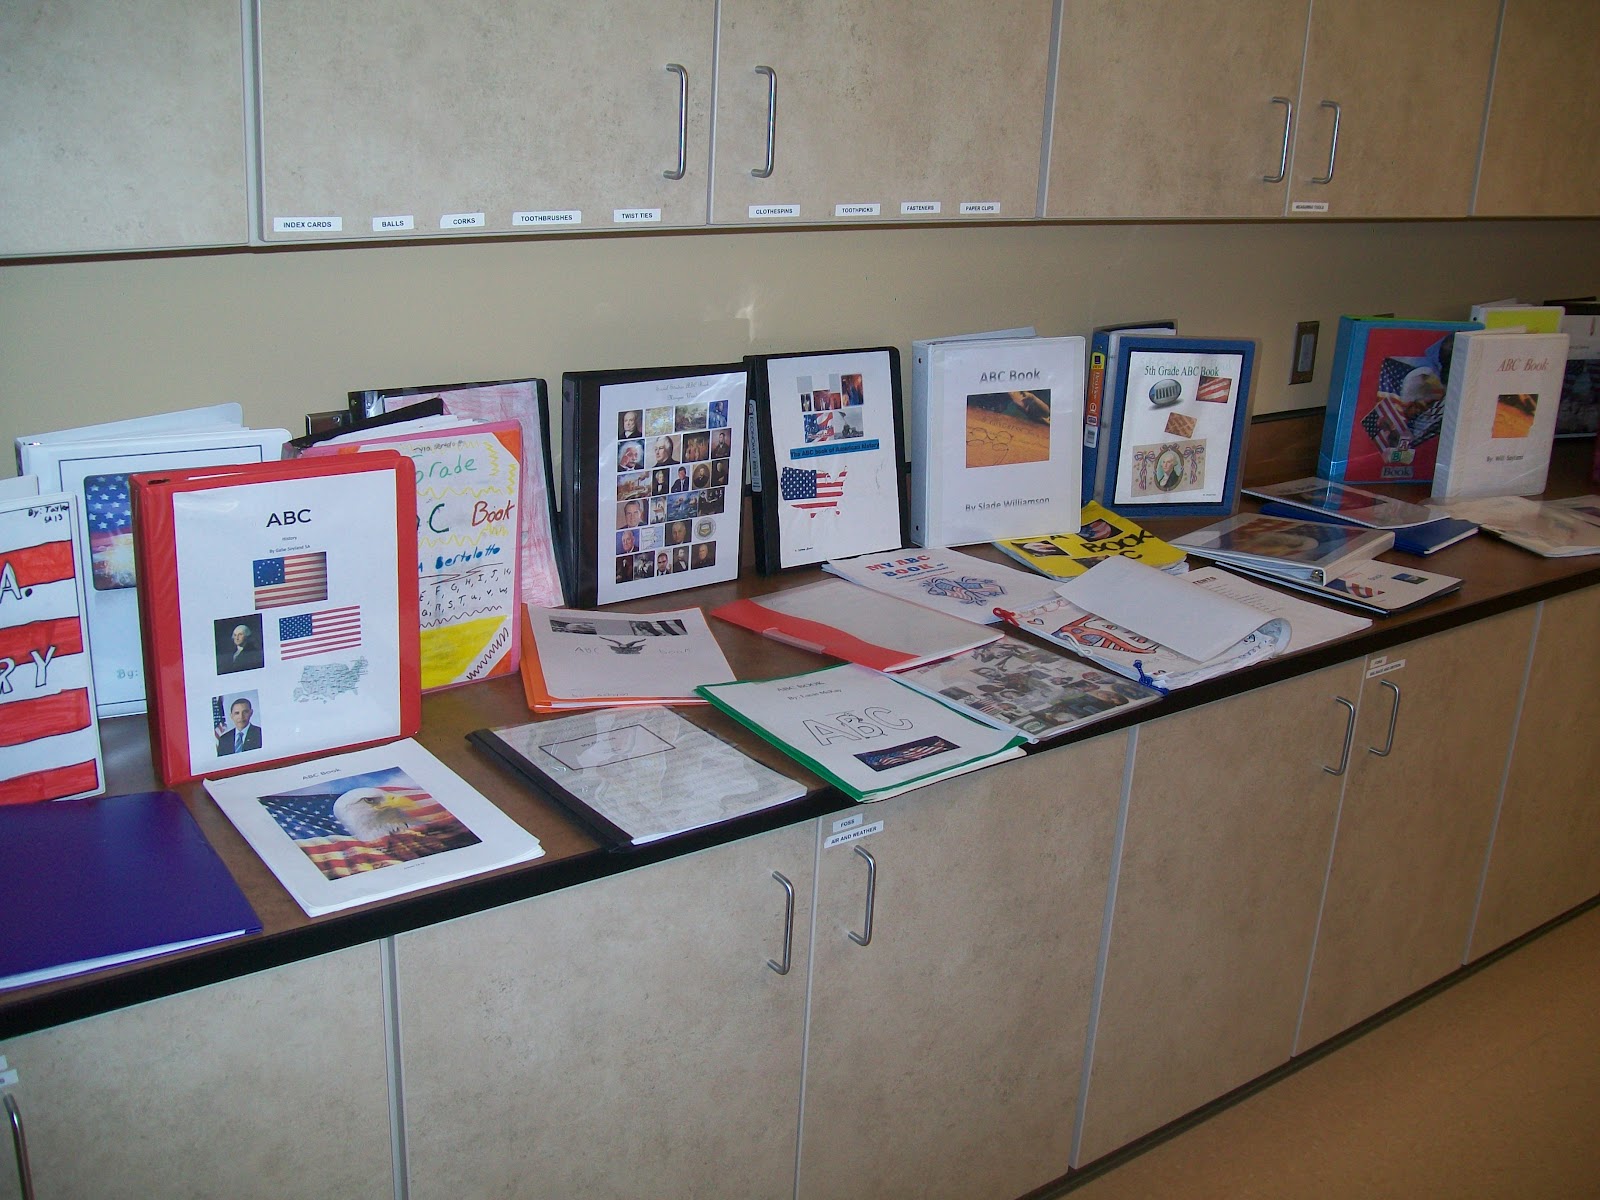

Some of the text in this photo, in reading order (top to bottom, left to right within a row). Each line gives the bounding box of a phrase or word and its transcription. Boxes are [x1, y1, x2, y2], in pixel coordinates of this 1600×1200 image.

[382, 220, 404, 228] BALLS
[520, 214, 573, 222] TOOTHBRUSHES
[979, 368, 1041, 383] ABC Book
[1144, 365, 1220, 376] 5th Grade ABC Book
[836, 444, 860, 452] American
[1384, 466, 1411, 477] Book
[978, 500, 1002, 510] Slade
[1004, 497, 1050, 507] Williamson
[266, 508, 312, 528] ABC
[472, 500, 516, 527] Book
[1080, 530, 1155, 552] BOOK
[864, 554, 930, 572] MY ABC
[881, 564, 935, 577] BOOK
[116, 668, 139, 680] By:
[802, 706, 914, 746] ABC
[302, 768, 342, 781] ABC Book
[840, 818, 855, 828] FOSS
[852, 826, 877, 838] WEATHER
